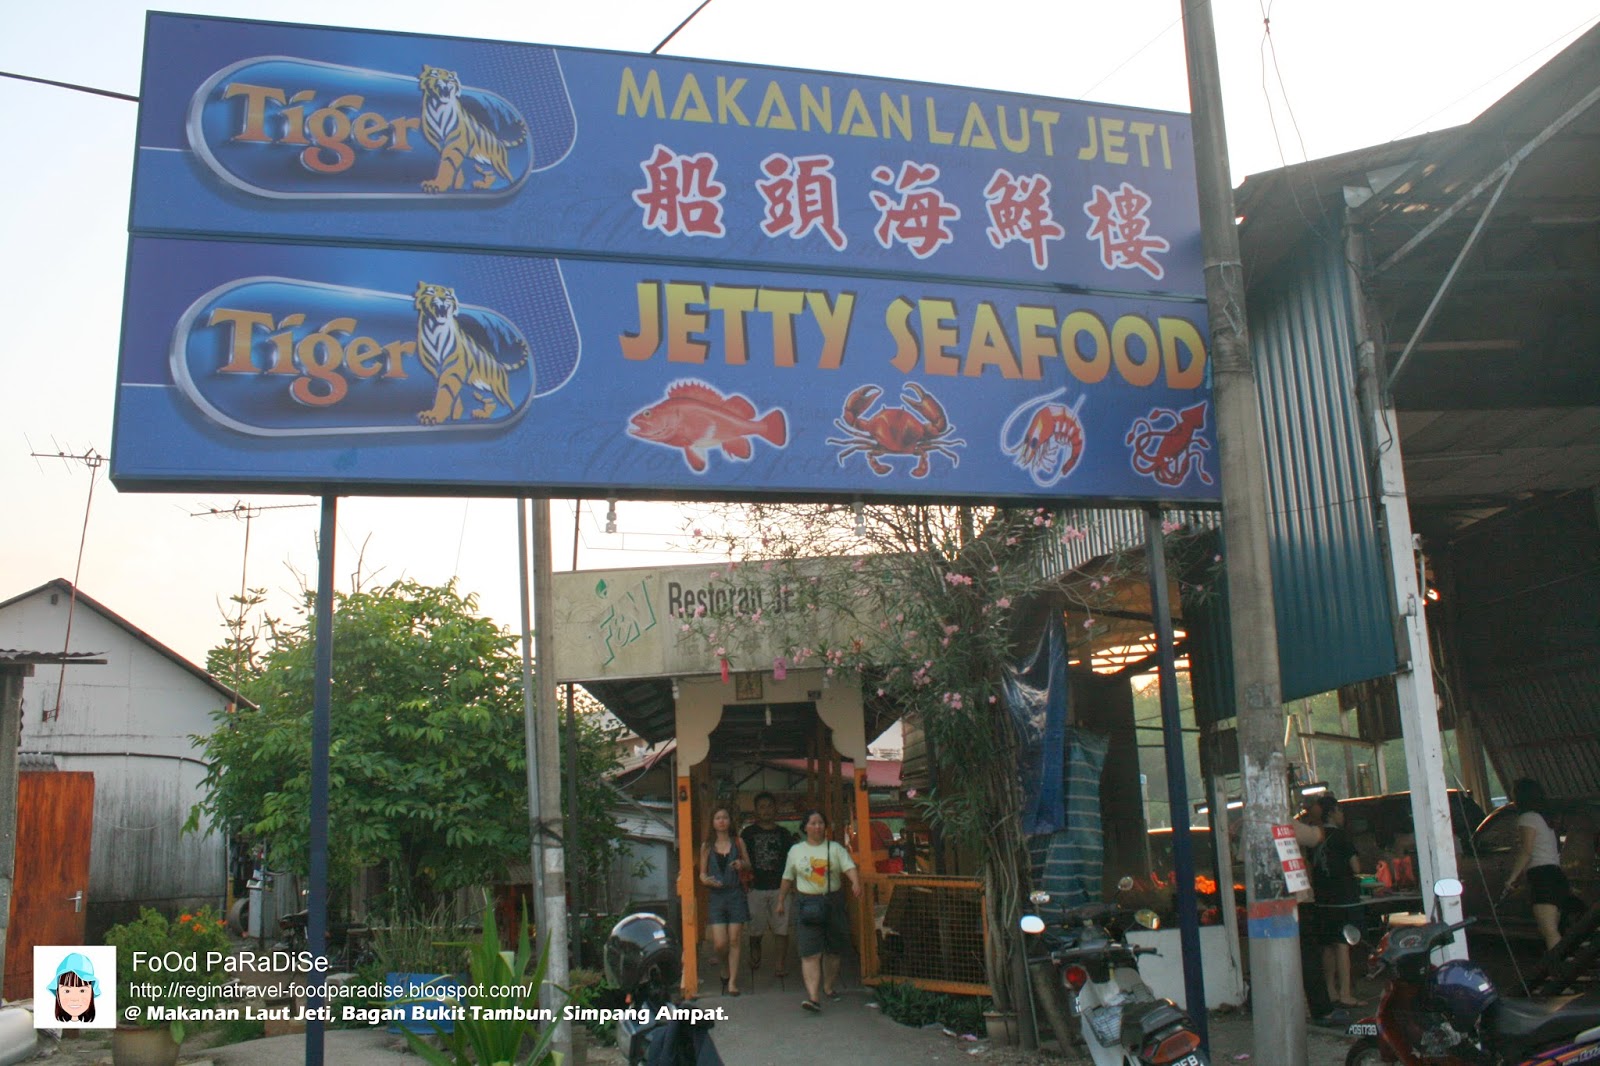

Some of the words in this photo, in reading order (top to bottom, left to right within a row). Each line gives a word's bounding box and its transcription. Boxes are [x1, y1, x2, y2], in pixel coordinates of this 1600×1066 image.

[222, 81, 421, 173] Tiger
[616, 66, 912, 141] MAKANAN
[926, 97, 1062, 156] LAUT
[1078, 115, 1173, 170] JETI
[631, 143, 1170, 281] 船頭海鮮樓
[207, 307, 417, 407] Tiger
[618, 279, 856, 370] JETTY
[884, 293, 1209, 390] SEAFOOD
